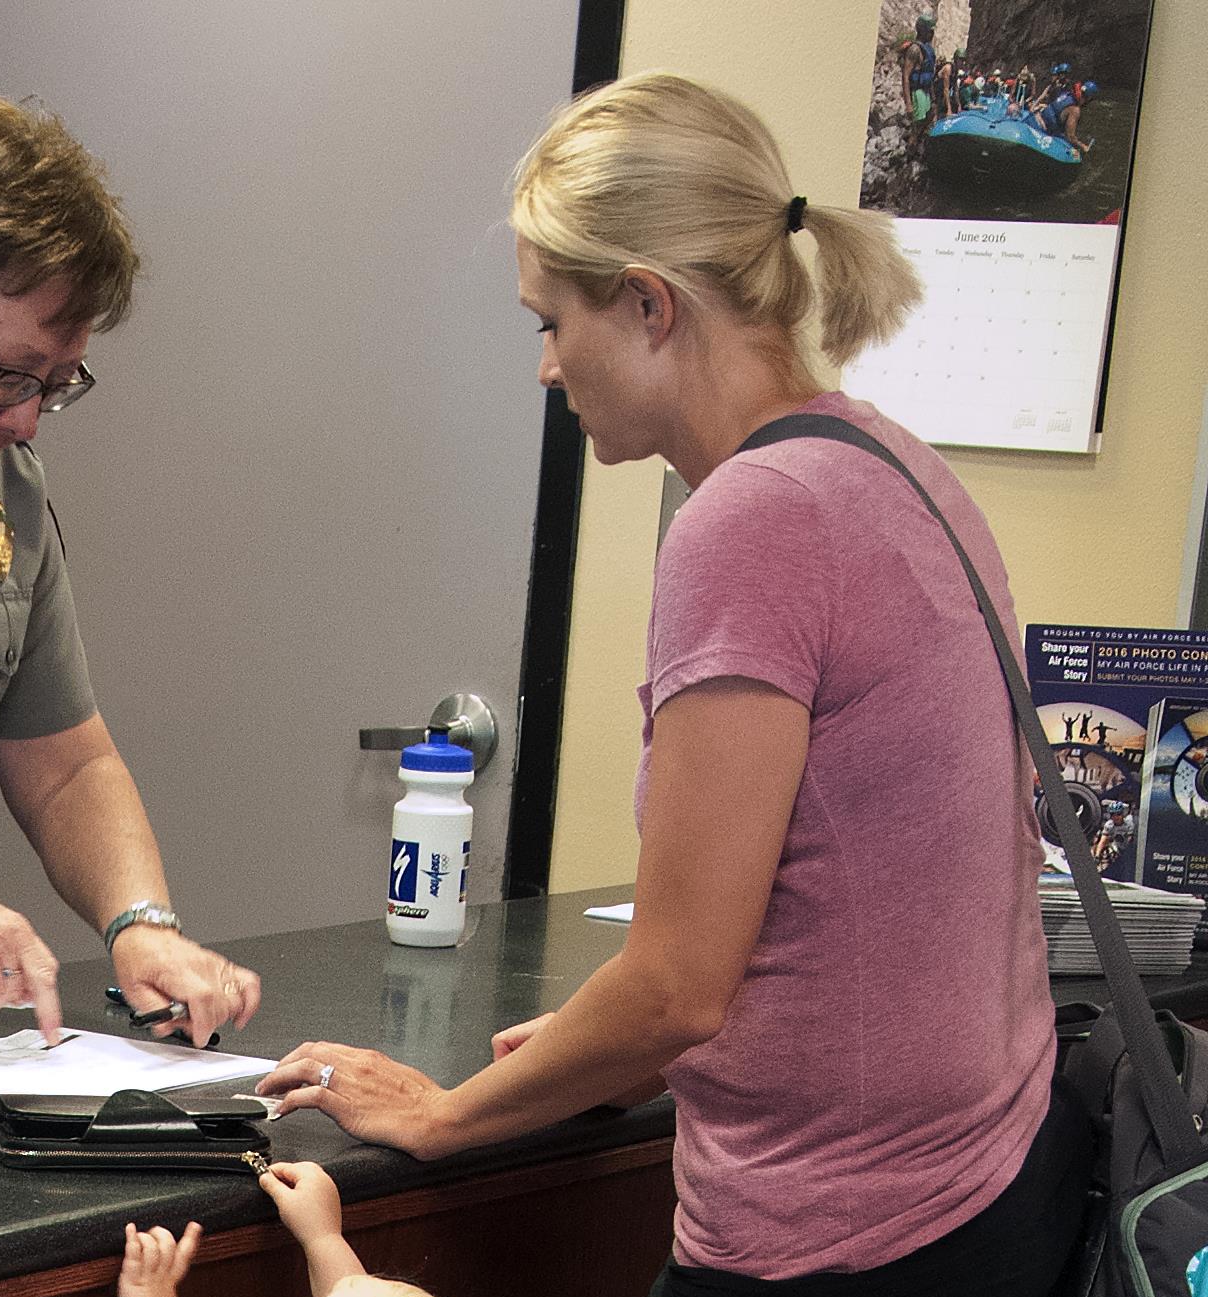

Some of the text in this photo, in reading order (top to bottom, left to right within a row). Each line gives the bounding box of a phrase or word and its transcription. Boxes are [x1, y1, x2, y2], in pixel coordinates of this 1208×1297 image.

[954, 231, 1006, 244] June 2016
[1043, 629, 1086, 637] BROUGHT
[1143, 633, 1158, 641] AIR
[1162, 634, 1191, 642] FORCE
[1041, 641, 1089, 655] Share your
[1098, 647, 1128, 658] 2016
[1132, 648, 1177, 660] PHOTO
[1048, 655, 1088, 667] Air Force
[1114, 661, 1130, 669] AIR
[1133, 662, 1165, 671] FORCE
[1168, 663, 1188, 672] LIFE
[1191, 664, 1201, 672] IN
[1063, 669, 1088, 682] Story
